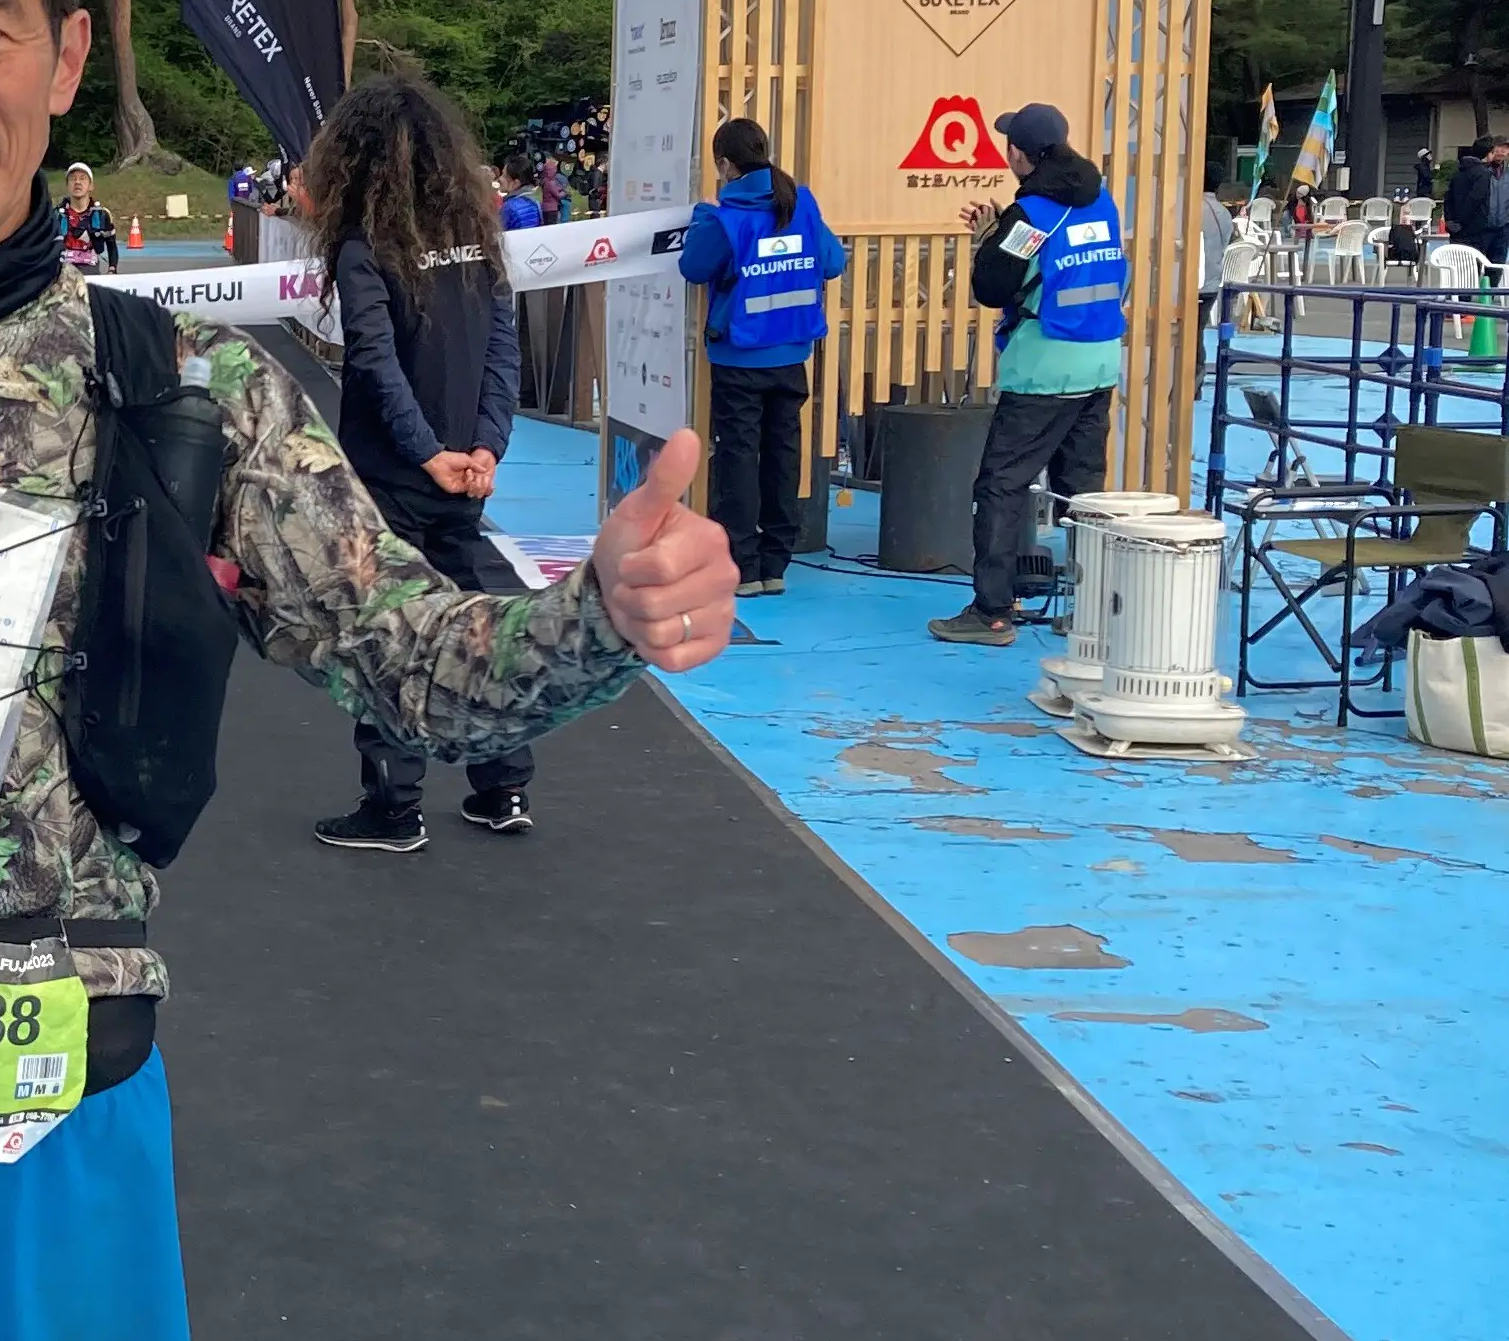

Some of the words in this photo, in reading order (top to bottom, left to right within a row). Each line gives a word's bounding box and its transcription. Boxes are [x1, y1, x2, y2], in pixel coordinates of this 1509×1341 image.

[929, 110, 979, 167] Q
[906, 173, 1005, 188] 富士急ハイランド
[153, 280, 242, 306] Mt.FUJI
